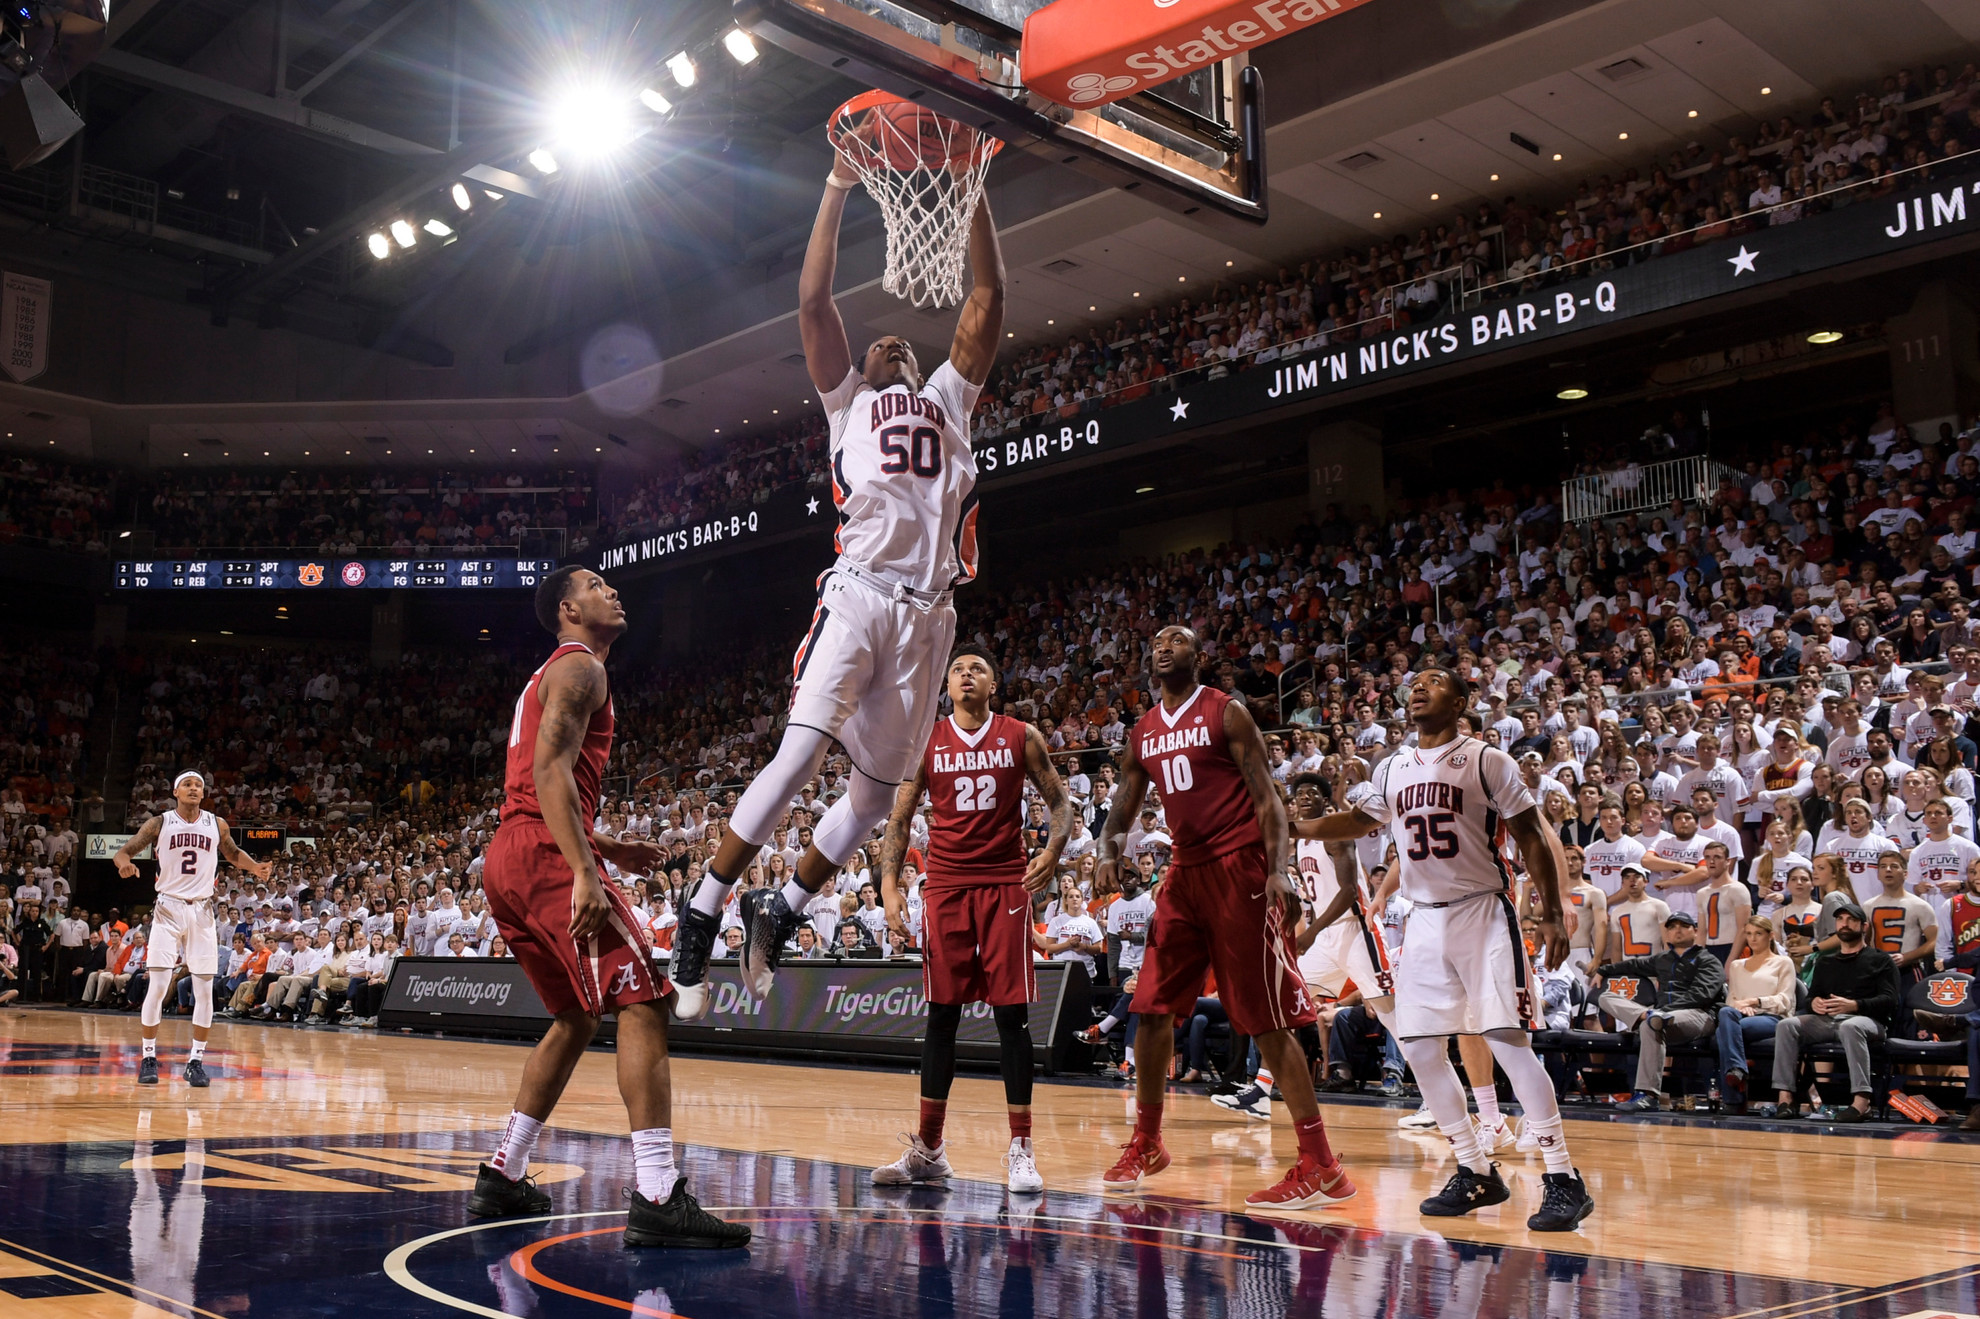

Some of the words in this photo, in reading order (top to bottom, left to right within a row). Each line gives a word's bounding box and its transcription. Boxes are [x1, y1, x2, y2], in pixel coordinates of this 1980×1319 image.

[1126, 0, 1341, 80] StateFar
[1267, 352, 1347, 398] JIM'N
[1359, 323, 1459, 374] NICK'S
[1471, 281, 1617, 346] BAR-B-Q
[870, 392, 946, 433] AUBURN
[880, 425, 941, 479] 50
[1005, 419, 1100, 466] BAR-B-Q
[598, 542, 637, 571] JIM'N
[642, 529, 688, 560] NICK'S
[693, 511, 759, 547] BAR-B-Q
[120, 565, 126, 573] 2
[135, 564, 153, 573] BLK
[175, 565, 182, 573] 2
[189, 563, 207, 573] AST
[260, 563, 278, 573] 3PT
[389, 562, 408, 572] 3PT
[461, 562, 479, 572] AST
[486, 563, 492, 571] 5
[517, 562, 535, 571] BLK
[120, 578, 126, 586] 9
[135, 577, 149, 587] TO
[173, 578, 184, 586] 15
[189, 577, 206, 587] REB
[260, 577, 273, 586] FG
[394, 576, 408, 586] FG
[461, 576, 479, 586] REB
[482, 576, 493, 585] 17
[521, 576, 535, 586] TO
[1141, 726, 1211, 760] ALABAMA
[933, 748, 1015, 773] ALABAMA
[1161, 754, 1194, 795] 10
[954, 775, 997, 812] 22
[1396, 782, 1464, 819] AUBURN
[169, 833, 212, 852] AUBURN
[247, 830, 279, 839] ALABAMA
[1404, 812, 1460, 861] 35
[181, 850, 198, 875] 2
[814, 907, 837, 916] AUBURN
[405, 975, 512, 1006] TigerGiving.org
